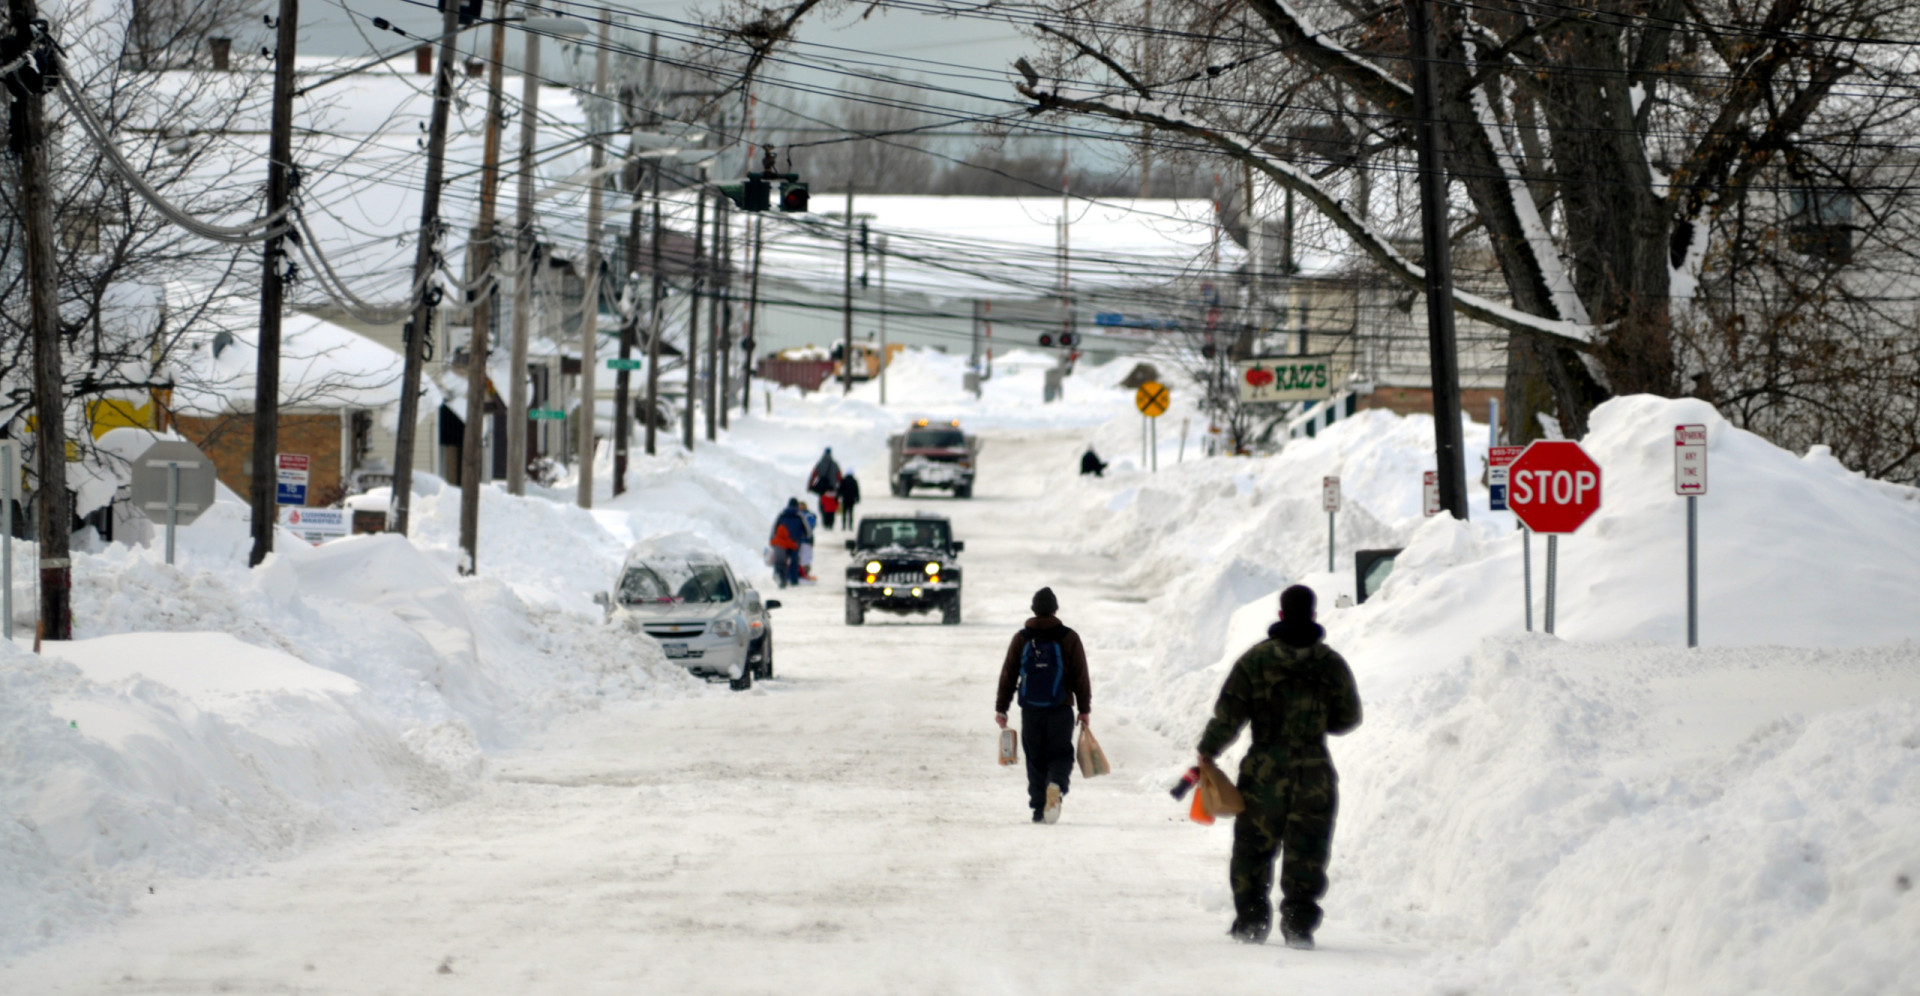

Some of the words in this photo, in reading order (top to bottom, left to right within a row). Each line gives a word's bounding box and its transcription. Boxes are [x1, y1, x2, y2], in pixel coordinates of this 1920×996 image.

[1685, 452, 1697, 461] ANY
[1683, 467, 1698, 477] TIME
[1512, 469, 1597, 505] STOP
